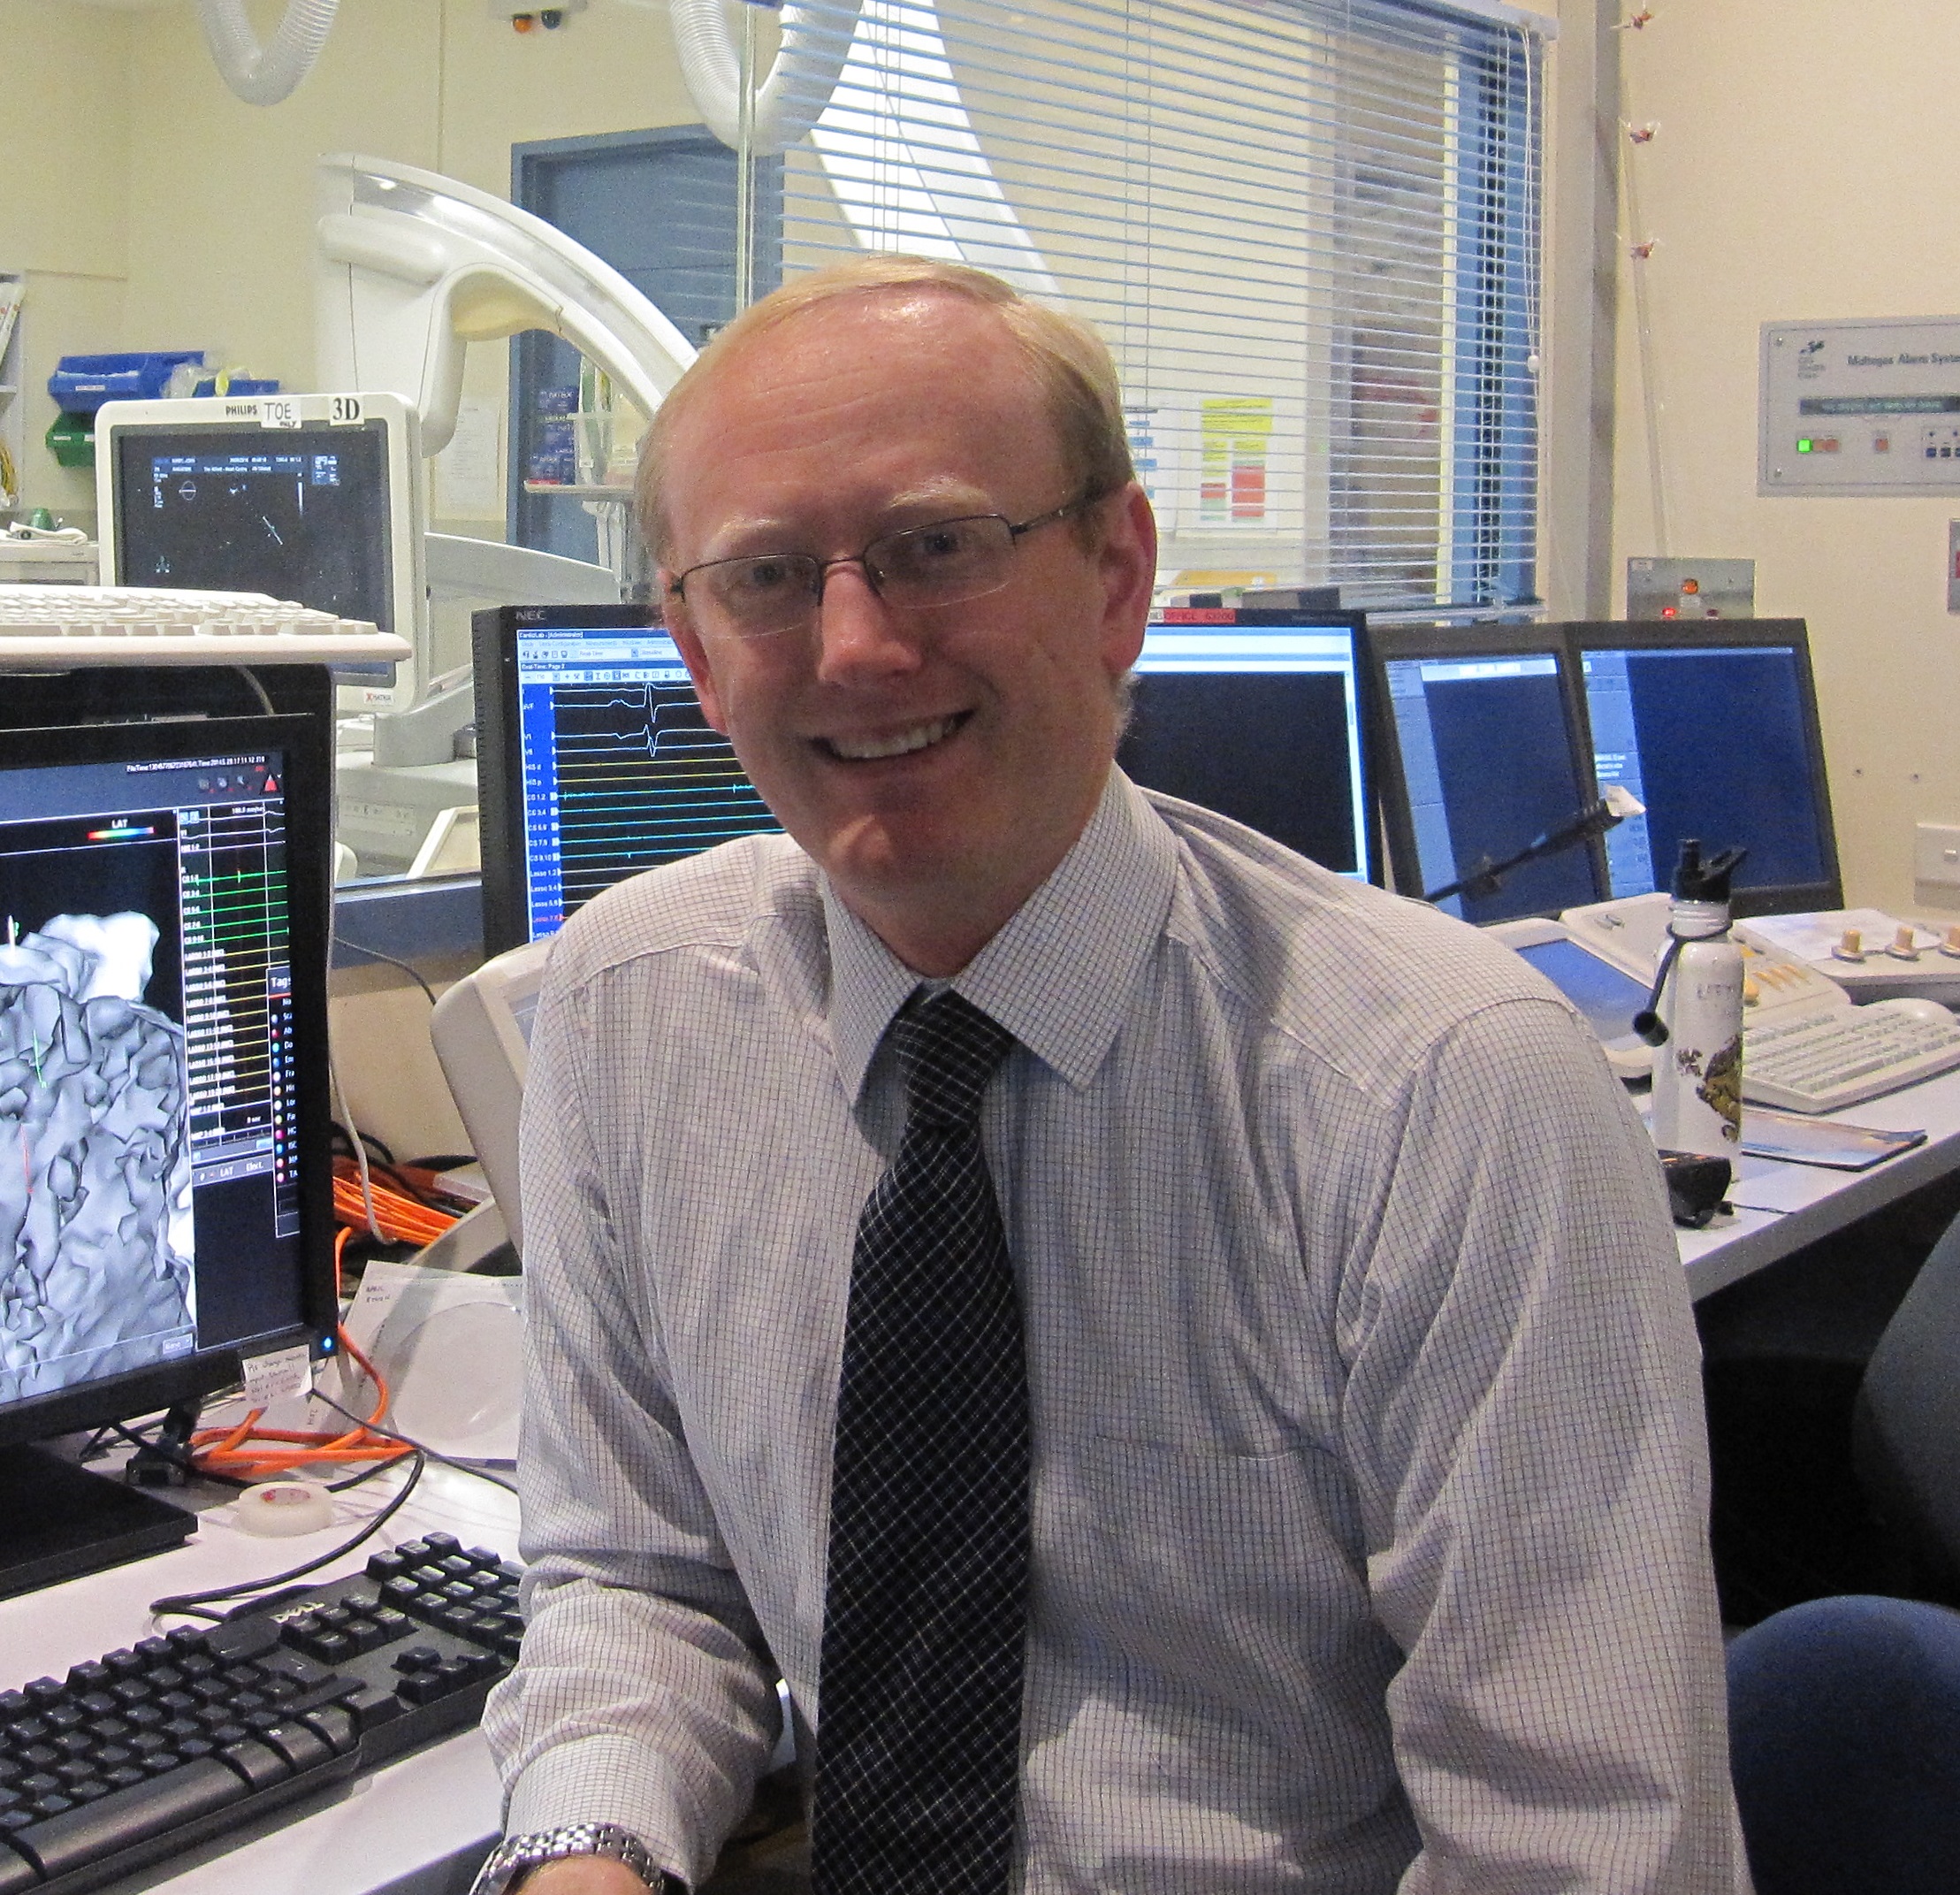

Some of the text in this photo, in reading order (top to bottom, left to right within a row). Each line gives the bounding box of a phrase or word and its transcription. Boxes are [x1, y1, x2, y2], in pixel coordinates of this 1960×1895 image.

[225, 405, 257, 416] PHILIPS
[264, 402, 292, 420] TOE
[332, 397, 361, 421] 3D
[515, 610, 546, 620] NEC
[111, 819, 128, 829] LAT
[220, 1167, 234, 1177] LAT
[269, 1601, 326, 1624] DELL
